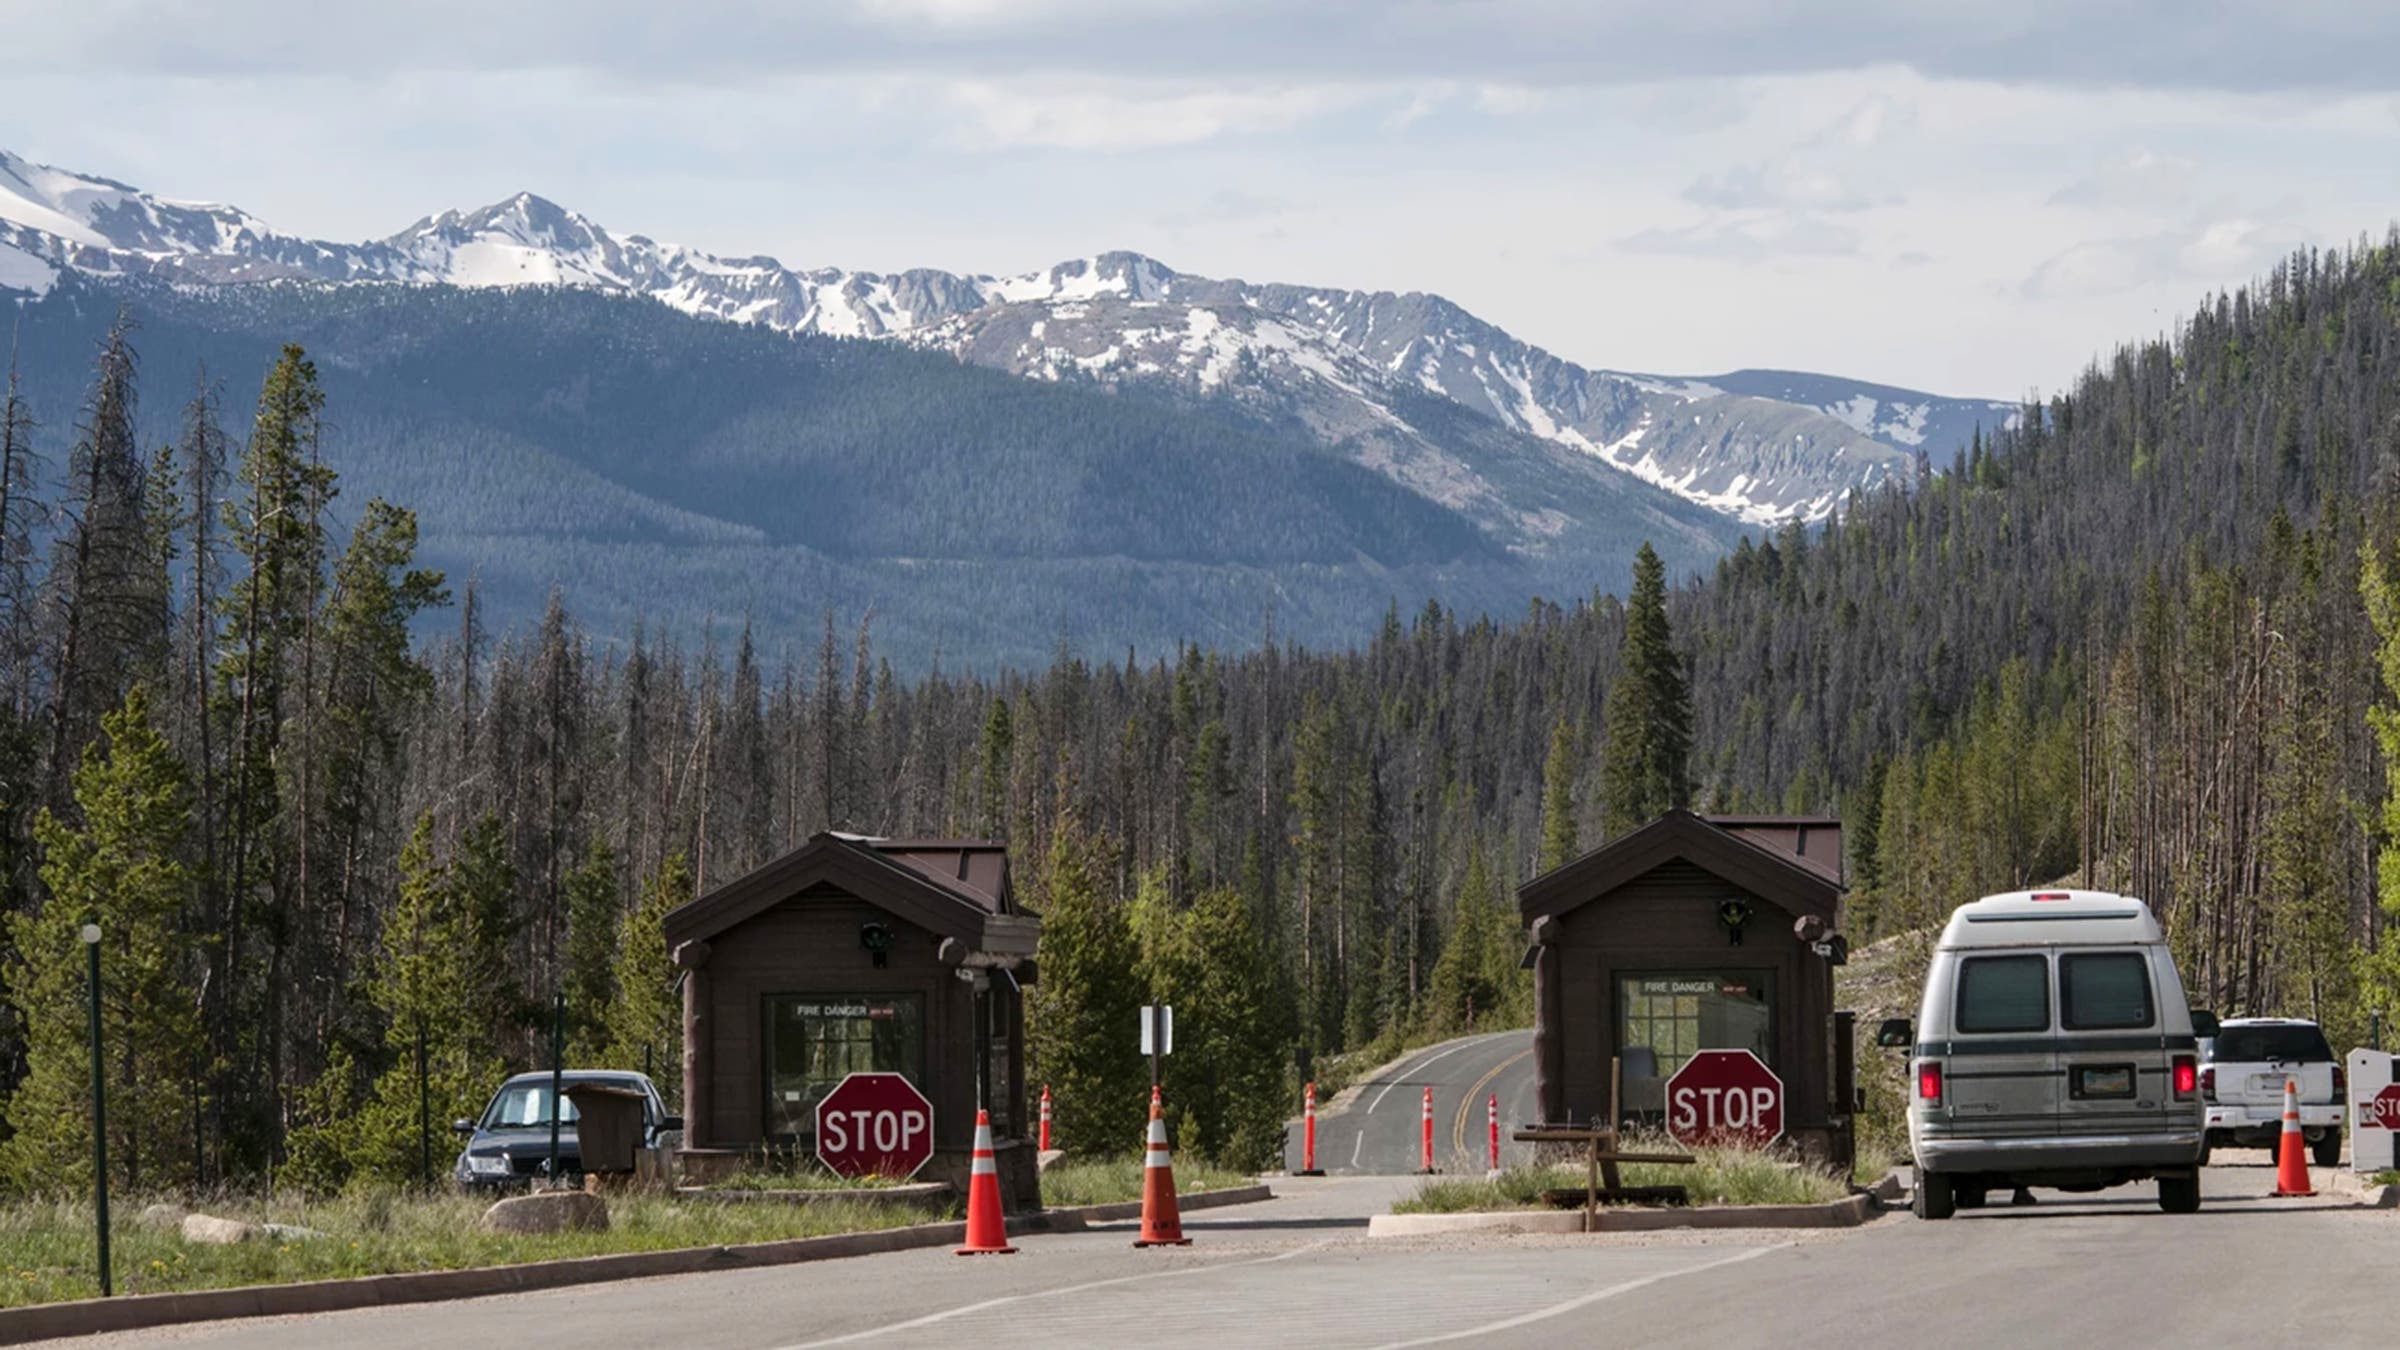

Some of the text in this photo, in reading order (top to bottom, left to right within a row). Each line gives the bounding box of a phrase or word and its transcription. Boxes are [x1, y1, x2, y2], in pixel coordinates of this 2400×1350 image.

[1645, 981, 1667, 992] FIRE
[1672, 981, 1715, 992] DANGER
[797, 1005, 820, 1016] FIRE
[824, 1005, 867, 1016] DANGER
[1674, 1087, 1775, 1129] STOP
[824, 1110, 926, 1152] STOP
